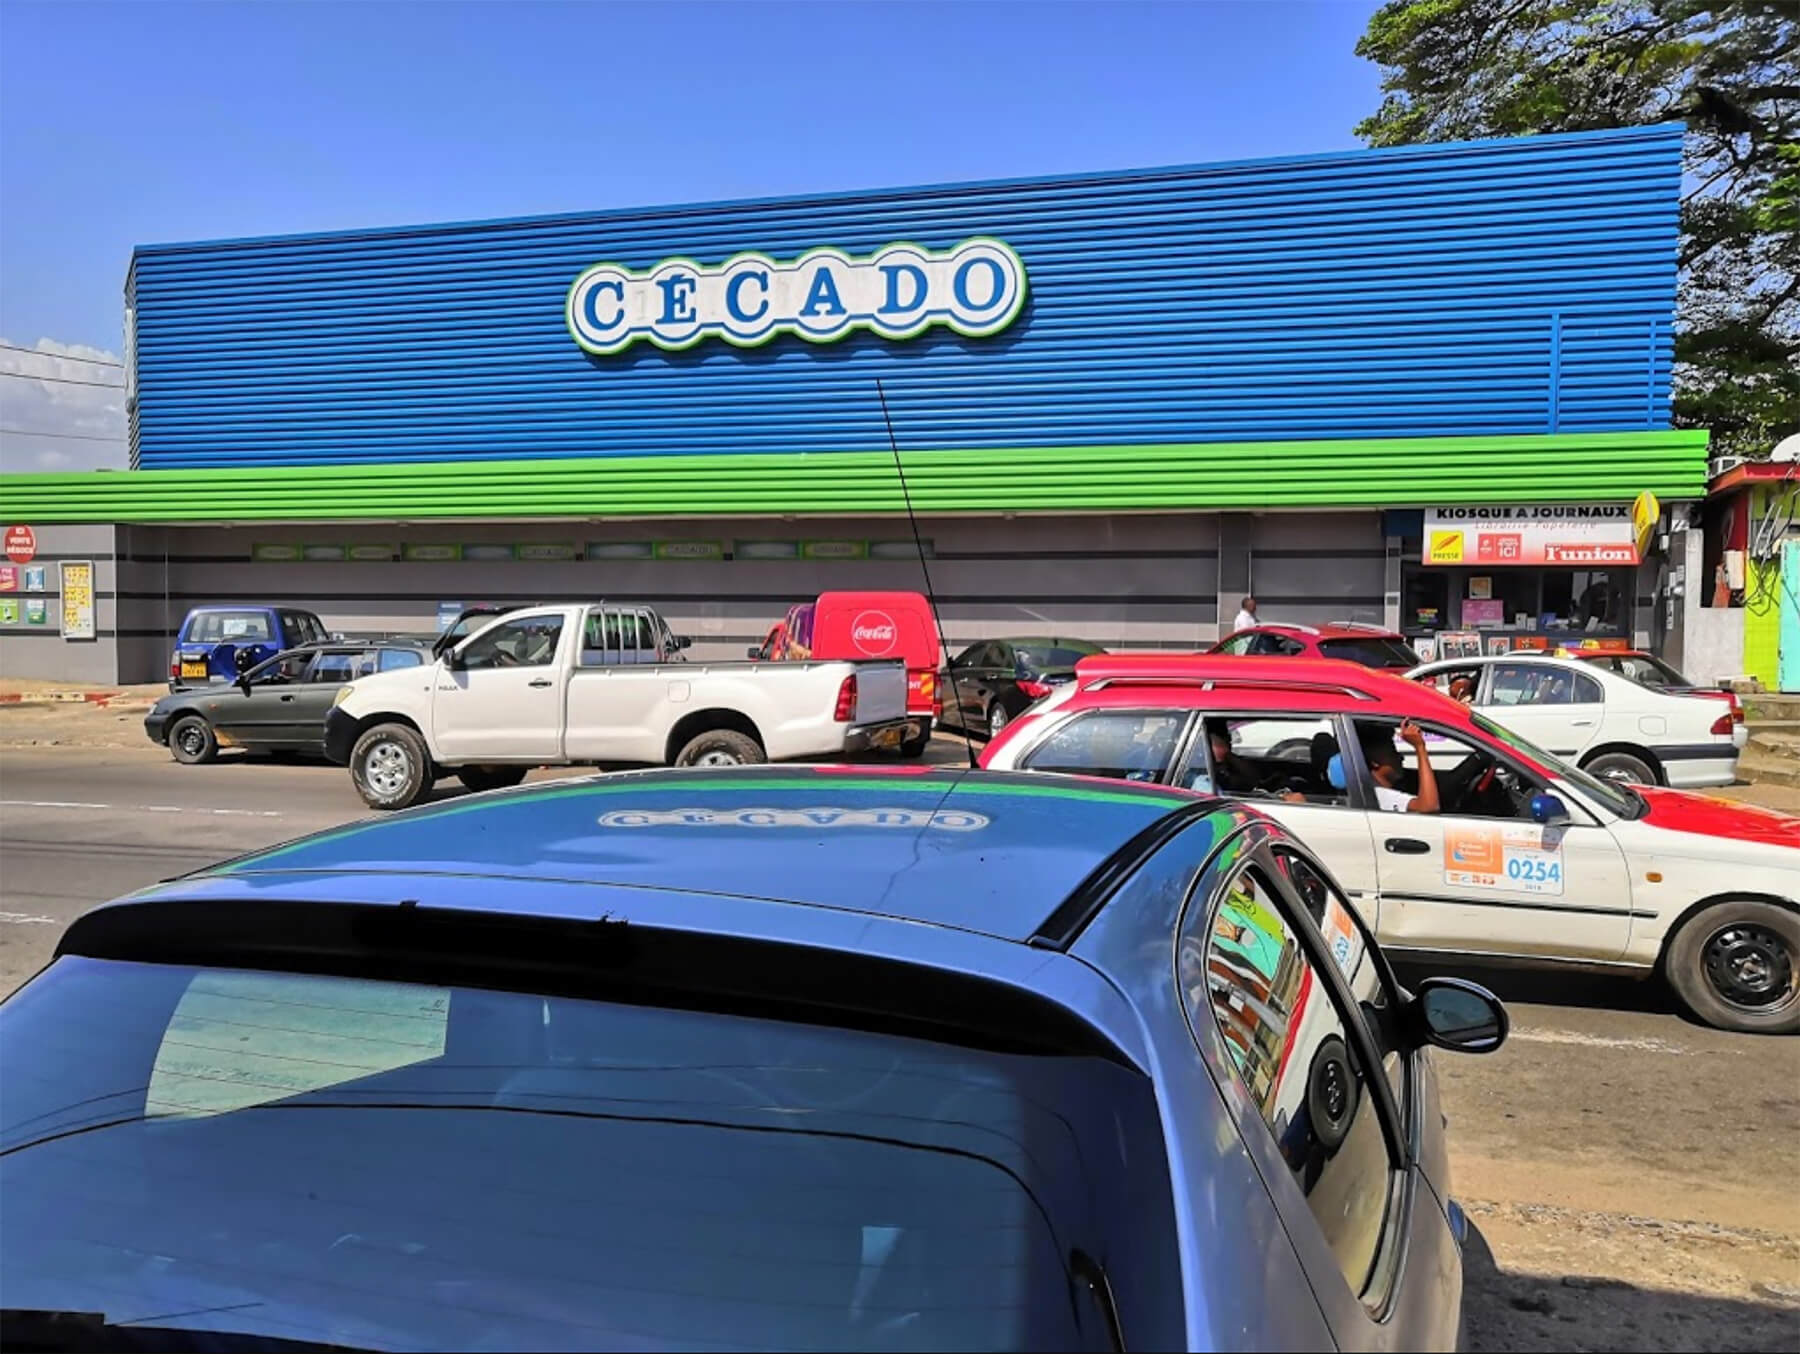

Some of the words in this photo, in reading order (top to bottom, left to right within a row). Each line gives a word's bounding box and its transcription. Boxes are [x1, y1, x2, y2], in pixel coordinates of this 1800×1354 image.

[1437, 506, 1512, 519] KIOSQUE
[1531, 506, 1628, 518] JOURNAUX
[1508, 858, 1560, 882] 0254
